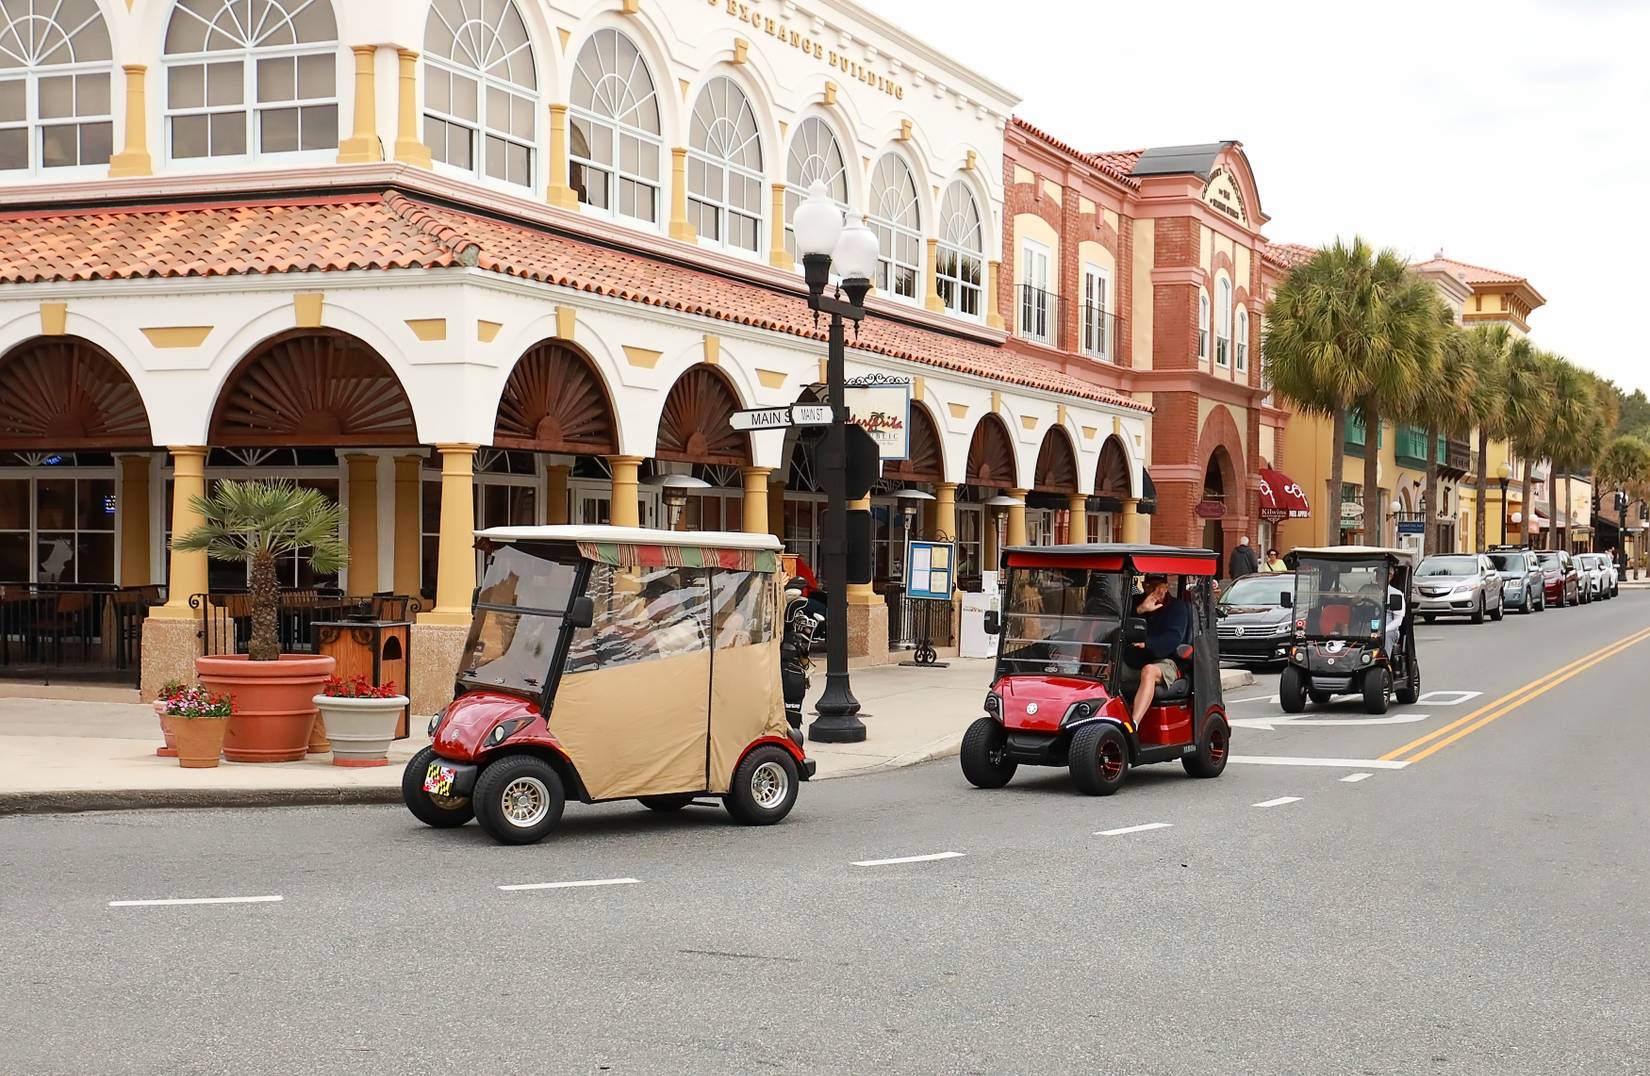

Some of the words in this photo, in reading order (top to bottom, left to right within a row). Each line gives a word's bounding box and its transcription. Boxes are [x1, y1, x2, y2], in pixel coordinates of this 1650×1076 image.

[726, 0, 823, 60] EXCHANGE
[829, 50, 904, 101] BUILDING
[751, 411, 780, 426] MAIN
[801, 408, 816, 421] MAIN
[816, 408, 823, 420] ST
